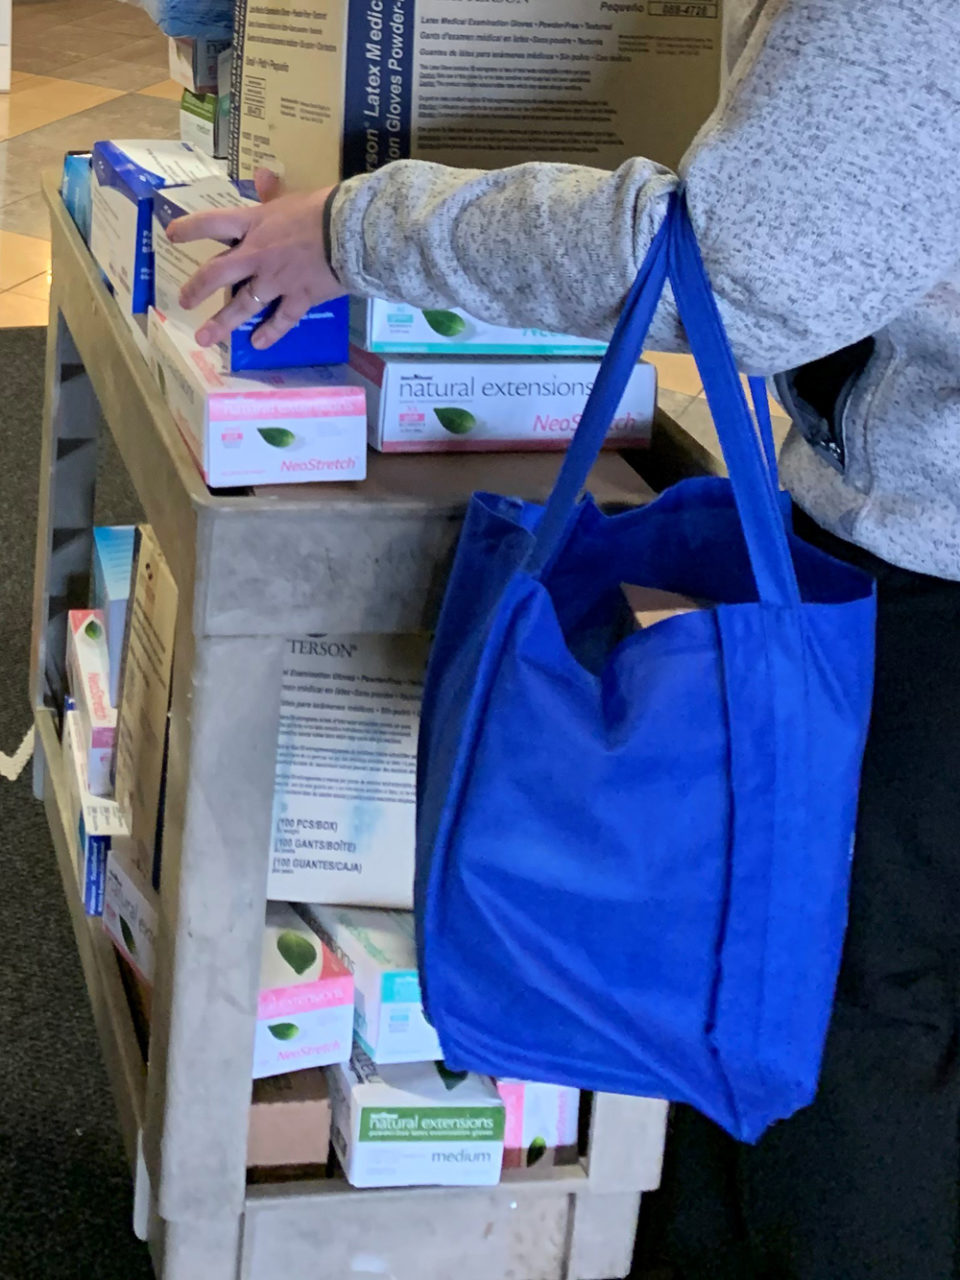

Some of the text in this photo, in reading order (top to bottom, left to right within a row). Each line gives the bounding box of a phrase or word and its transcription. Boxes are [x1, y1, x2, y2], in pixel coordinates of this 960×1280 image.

[601, 1, 645, 14] Pequeño
[420, 16, 439, 25] Latex
[440, 17, 467, 26] Medical
[468, 18, 509, 26] Examination
[510, 19, 533, 28] Gloves
[420, 31, 441, 40] Gants
[419, 47, 448, 56] Guantes
[364, 64, 381, 118] Latex
[386, 75, 402, 132] Gloves
[399, 374, 593, 398] natural extensions
[280, 457, 356, 472] NeoStretch
[289, 639, 353, 658] TERSON
[296, 819, 338, 834] PCS/BOX)
[369, 1114, 419, 1130] natural
[421, 1114, 495, 1130] extensions
[431, 1150, 492, 1163] medium
